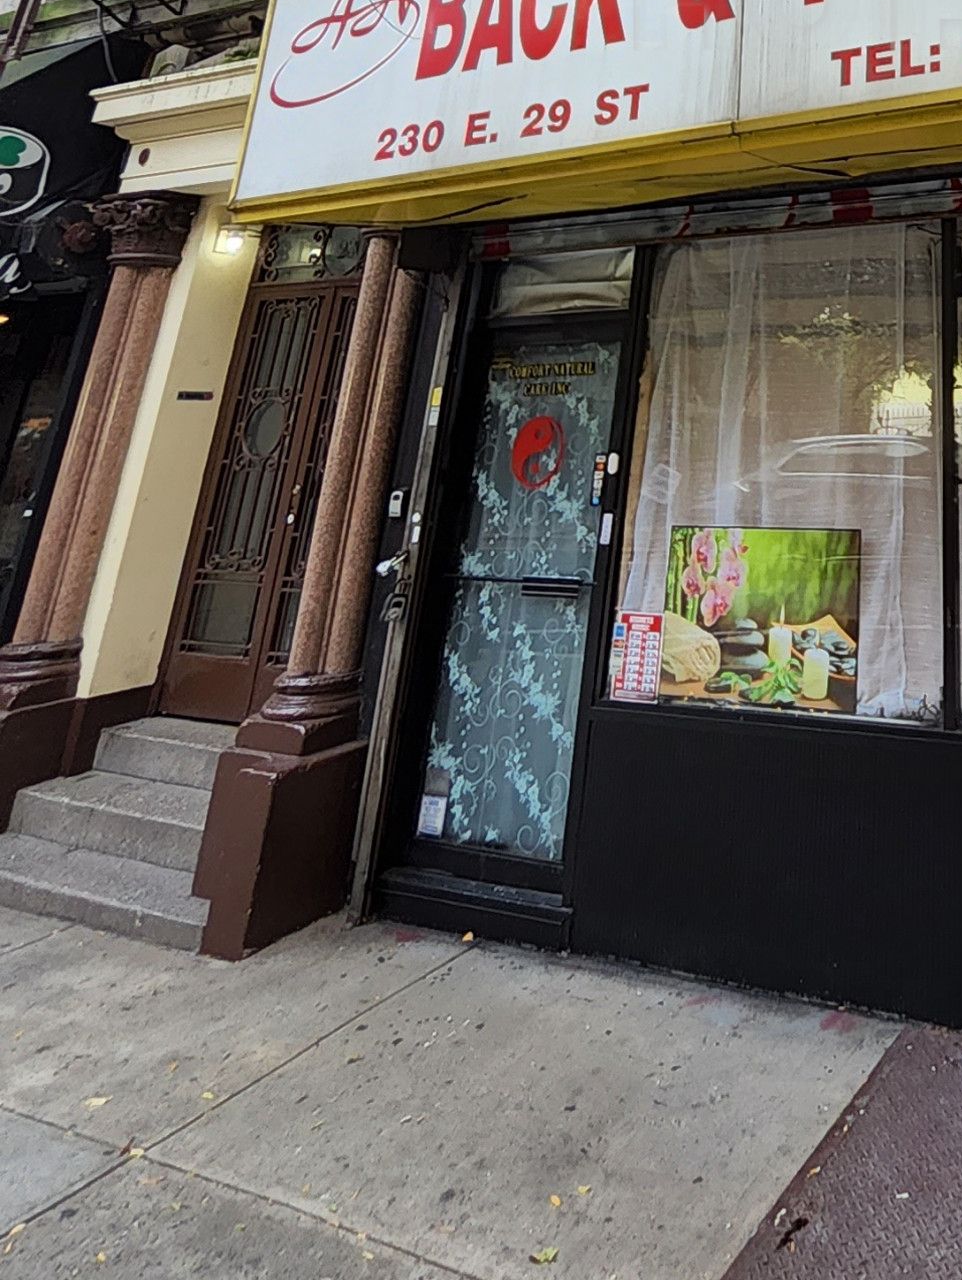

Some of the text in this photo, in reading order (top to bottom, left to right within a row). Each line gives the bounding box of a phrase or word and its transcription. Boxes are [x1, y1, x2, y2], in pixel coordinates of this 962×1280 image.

[830, 38, 942, 87] TEL:
[374, 83, 650, 161] 230 E. 29 ST
[552, 361, 595, 376] NATURAL
